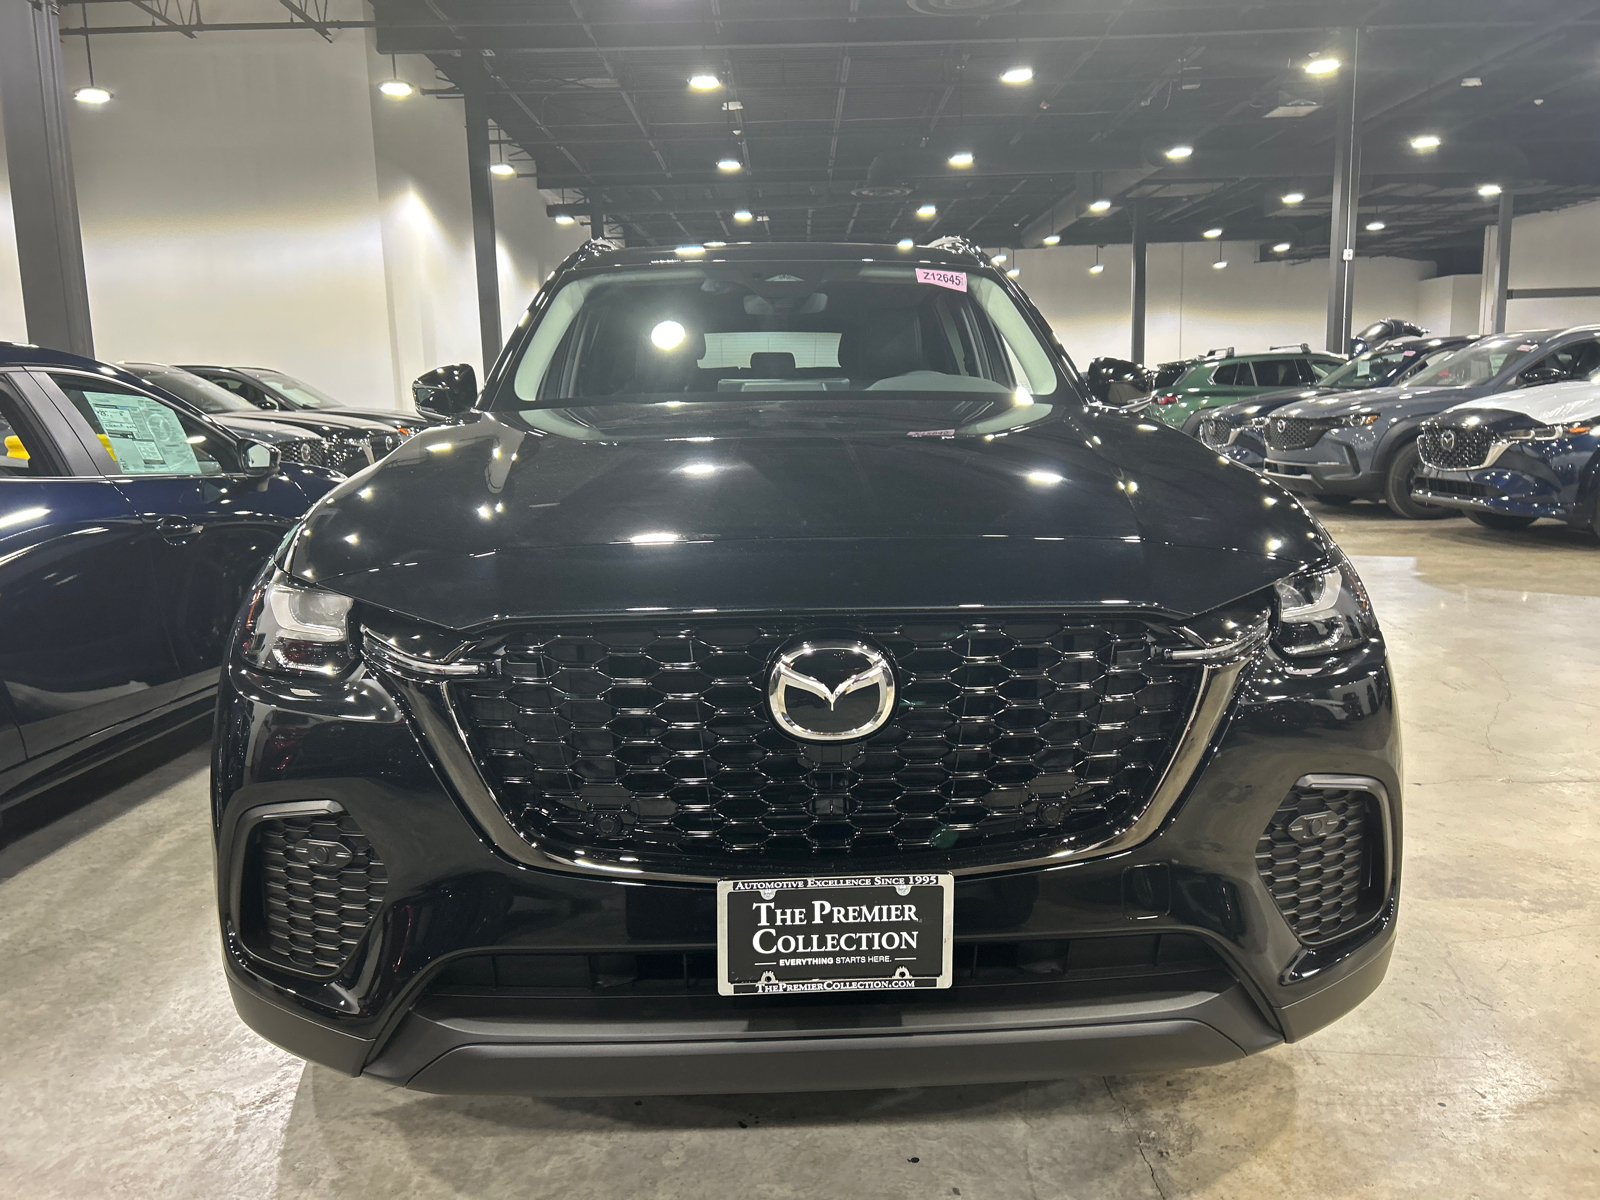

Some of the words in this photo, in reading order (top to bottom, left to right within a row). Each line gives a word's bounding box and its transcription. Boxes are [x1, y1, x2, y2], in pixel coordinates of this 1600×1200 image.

[923, 272, 961, 286] Z12645
[735, 881, 804, 890] AUTOMOTIVE
[807, 878, 872, 888] EXCELLENCE
[874, 877, 905, 886] SINCE
[908, 876, 937, 885] 1995
[752, 902, 807, 926] THE
[811, 900, 918, 924] PREMIER
[752, 928, 918, 954] COLLECTION
[779, 958, 834, 966] EVERYTHING
[835, 957, 866, 965] STARTS
[868, 956, 892, 964] HERE.
